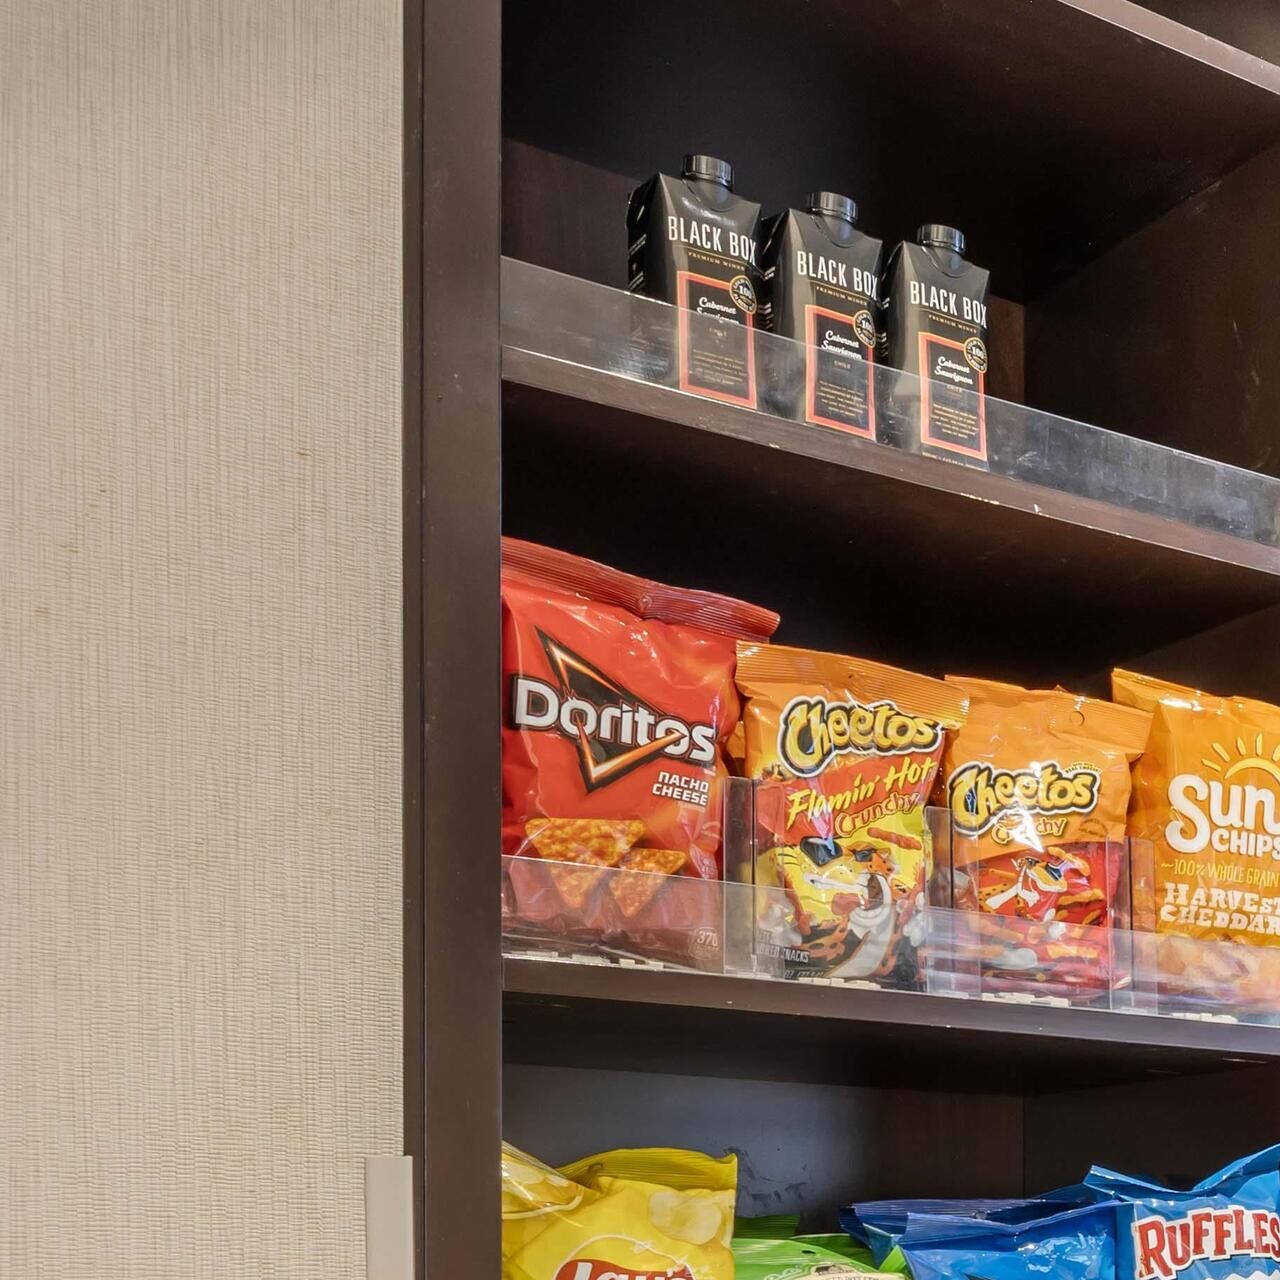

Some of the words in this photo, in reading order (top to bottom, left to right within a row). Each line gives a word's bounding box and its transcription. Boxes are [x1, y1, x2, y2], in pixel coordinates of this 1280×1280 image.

[668, 216, 722, 253] BLACK
[730, 234, 756, 265] BOX
[688, 251, 719, 266] PREMIUM
[723, 260, 745, 271] WINES
[797, 251, 847, 287] BLACK
[854, 270, 878, 300] BOX
[699, 297, 736, 315] Cabernet
[816, 285, 843, 301] PREMIUM
[846, 294, 867, 306] WINES
[910, 281, 958, 316] BLACK
[963, 300, 987, 329] BOX
[929, 315, 955, 329] PREMIUM
[958, 323, 977, 334] WINES
[821, 340, 862, 360] Sauvignon
[826, 331, 859, 349] Cabernet
[934, 365, 973, 384] Sauvignon
[938, 356, 970, 373] Cabernet
[515, 678, 715, 760] Doritos
[784, 700, 938, 772] Cheetos
[652, 782, 708, 806] CHEESE
[659, 772, 709, 793] NACHO
[787, 773, 881, 829] Flamin'
[884, 759, 935, 792] Hot
[952, 766, 1093, 827] Cheetos
[836, 792, 922, 838] Crunchy
[1175, 859, 1205, 876] 100%
[1208, 864, 1244, 883] WHOLE
[1247, 868, 1279, 888] GRAIN
